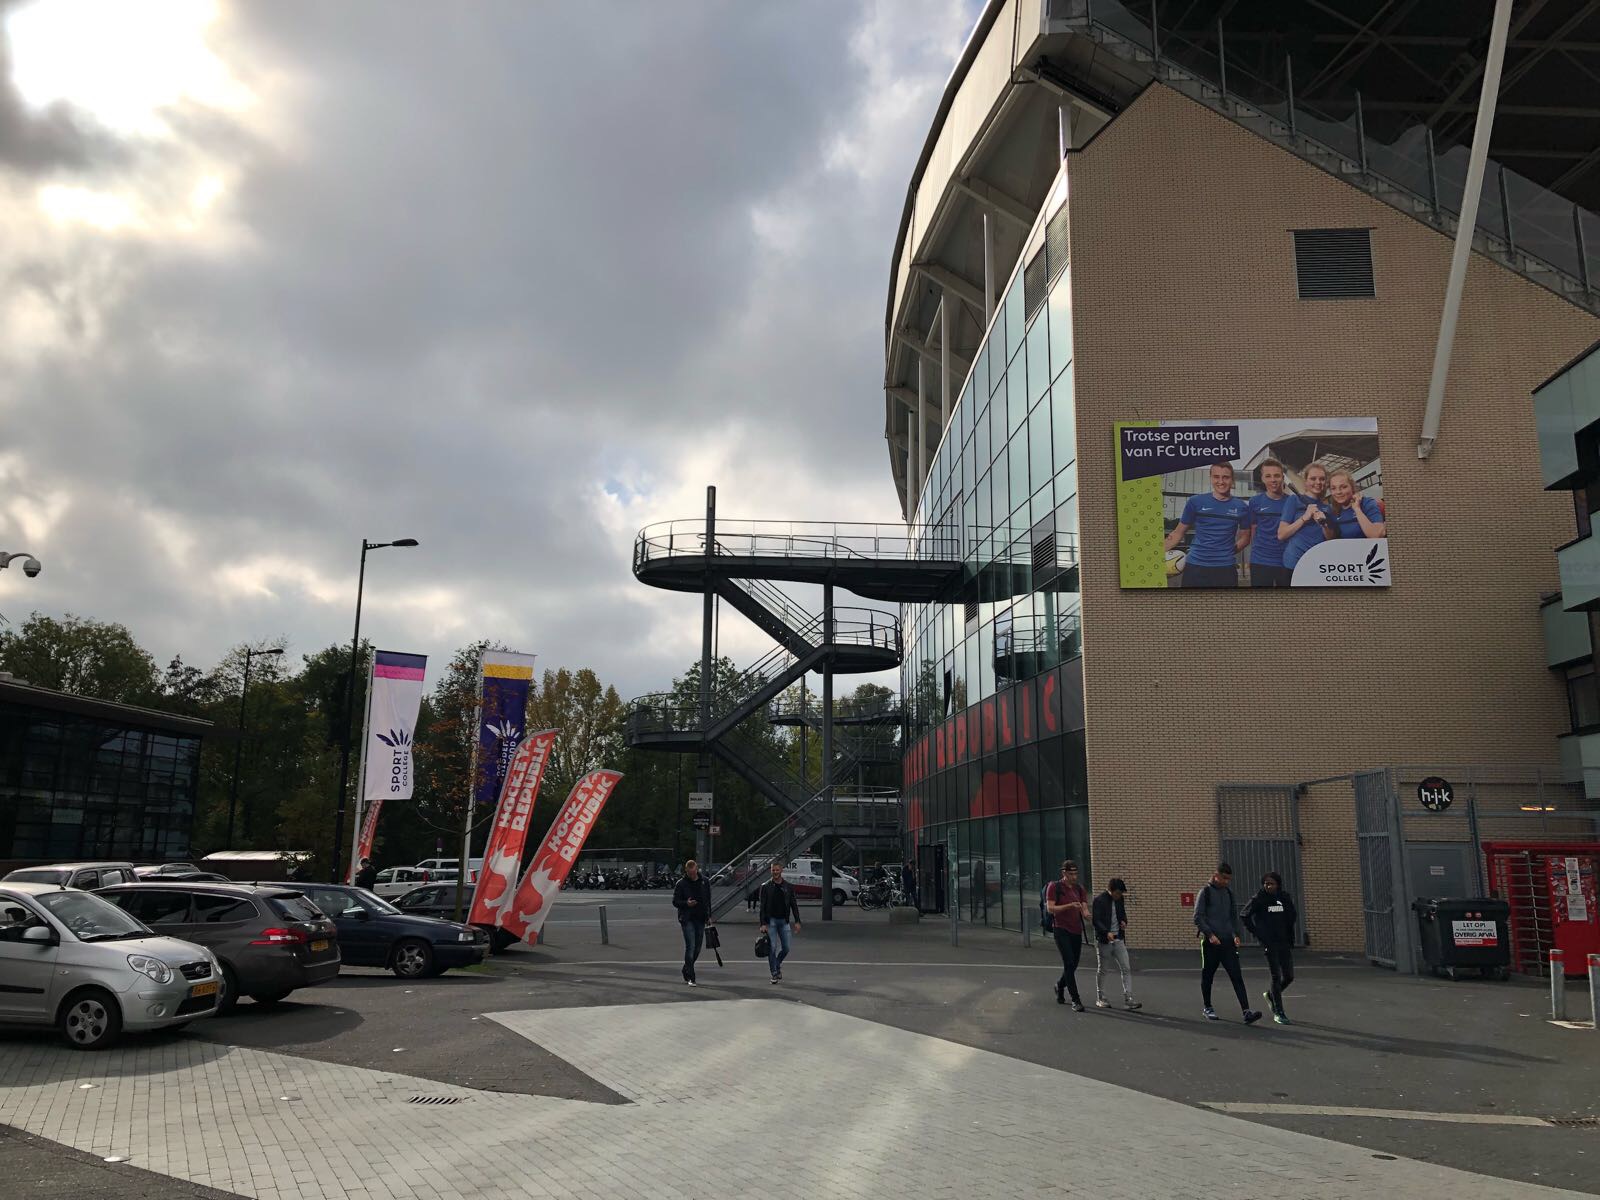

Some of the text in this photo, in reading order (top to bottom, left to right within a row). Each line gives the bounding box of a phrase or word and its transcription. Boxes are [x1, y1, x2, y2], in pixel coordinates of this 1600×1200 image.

[1124, 430, 1230, 444] Trotse partner
[1125, 445, 1236, 457] van FC Utrecht
[1319, 564, 1364, 574] SPORT
[936, 674, 1057, 769] REPUBLIC
[391, 749, 402, 792] SPORT
[498, 742, 531, 828] HOCKEY
[511, 738, 550, 831] REPUBLIC
[547, 776, 594, 852] HOCKEY
[560, 775, 613, 862] REPUBLIC
